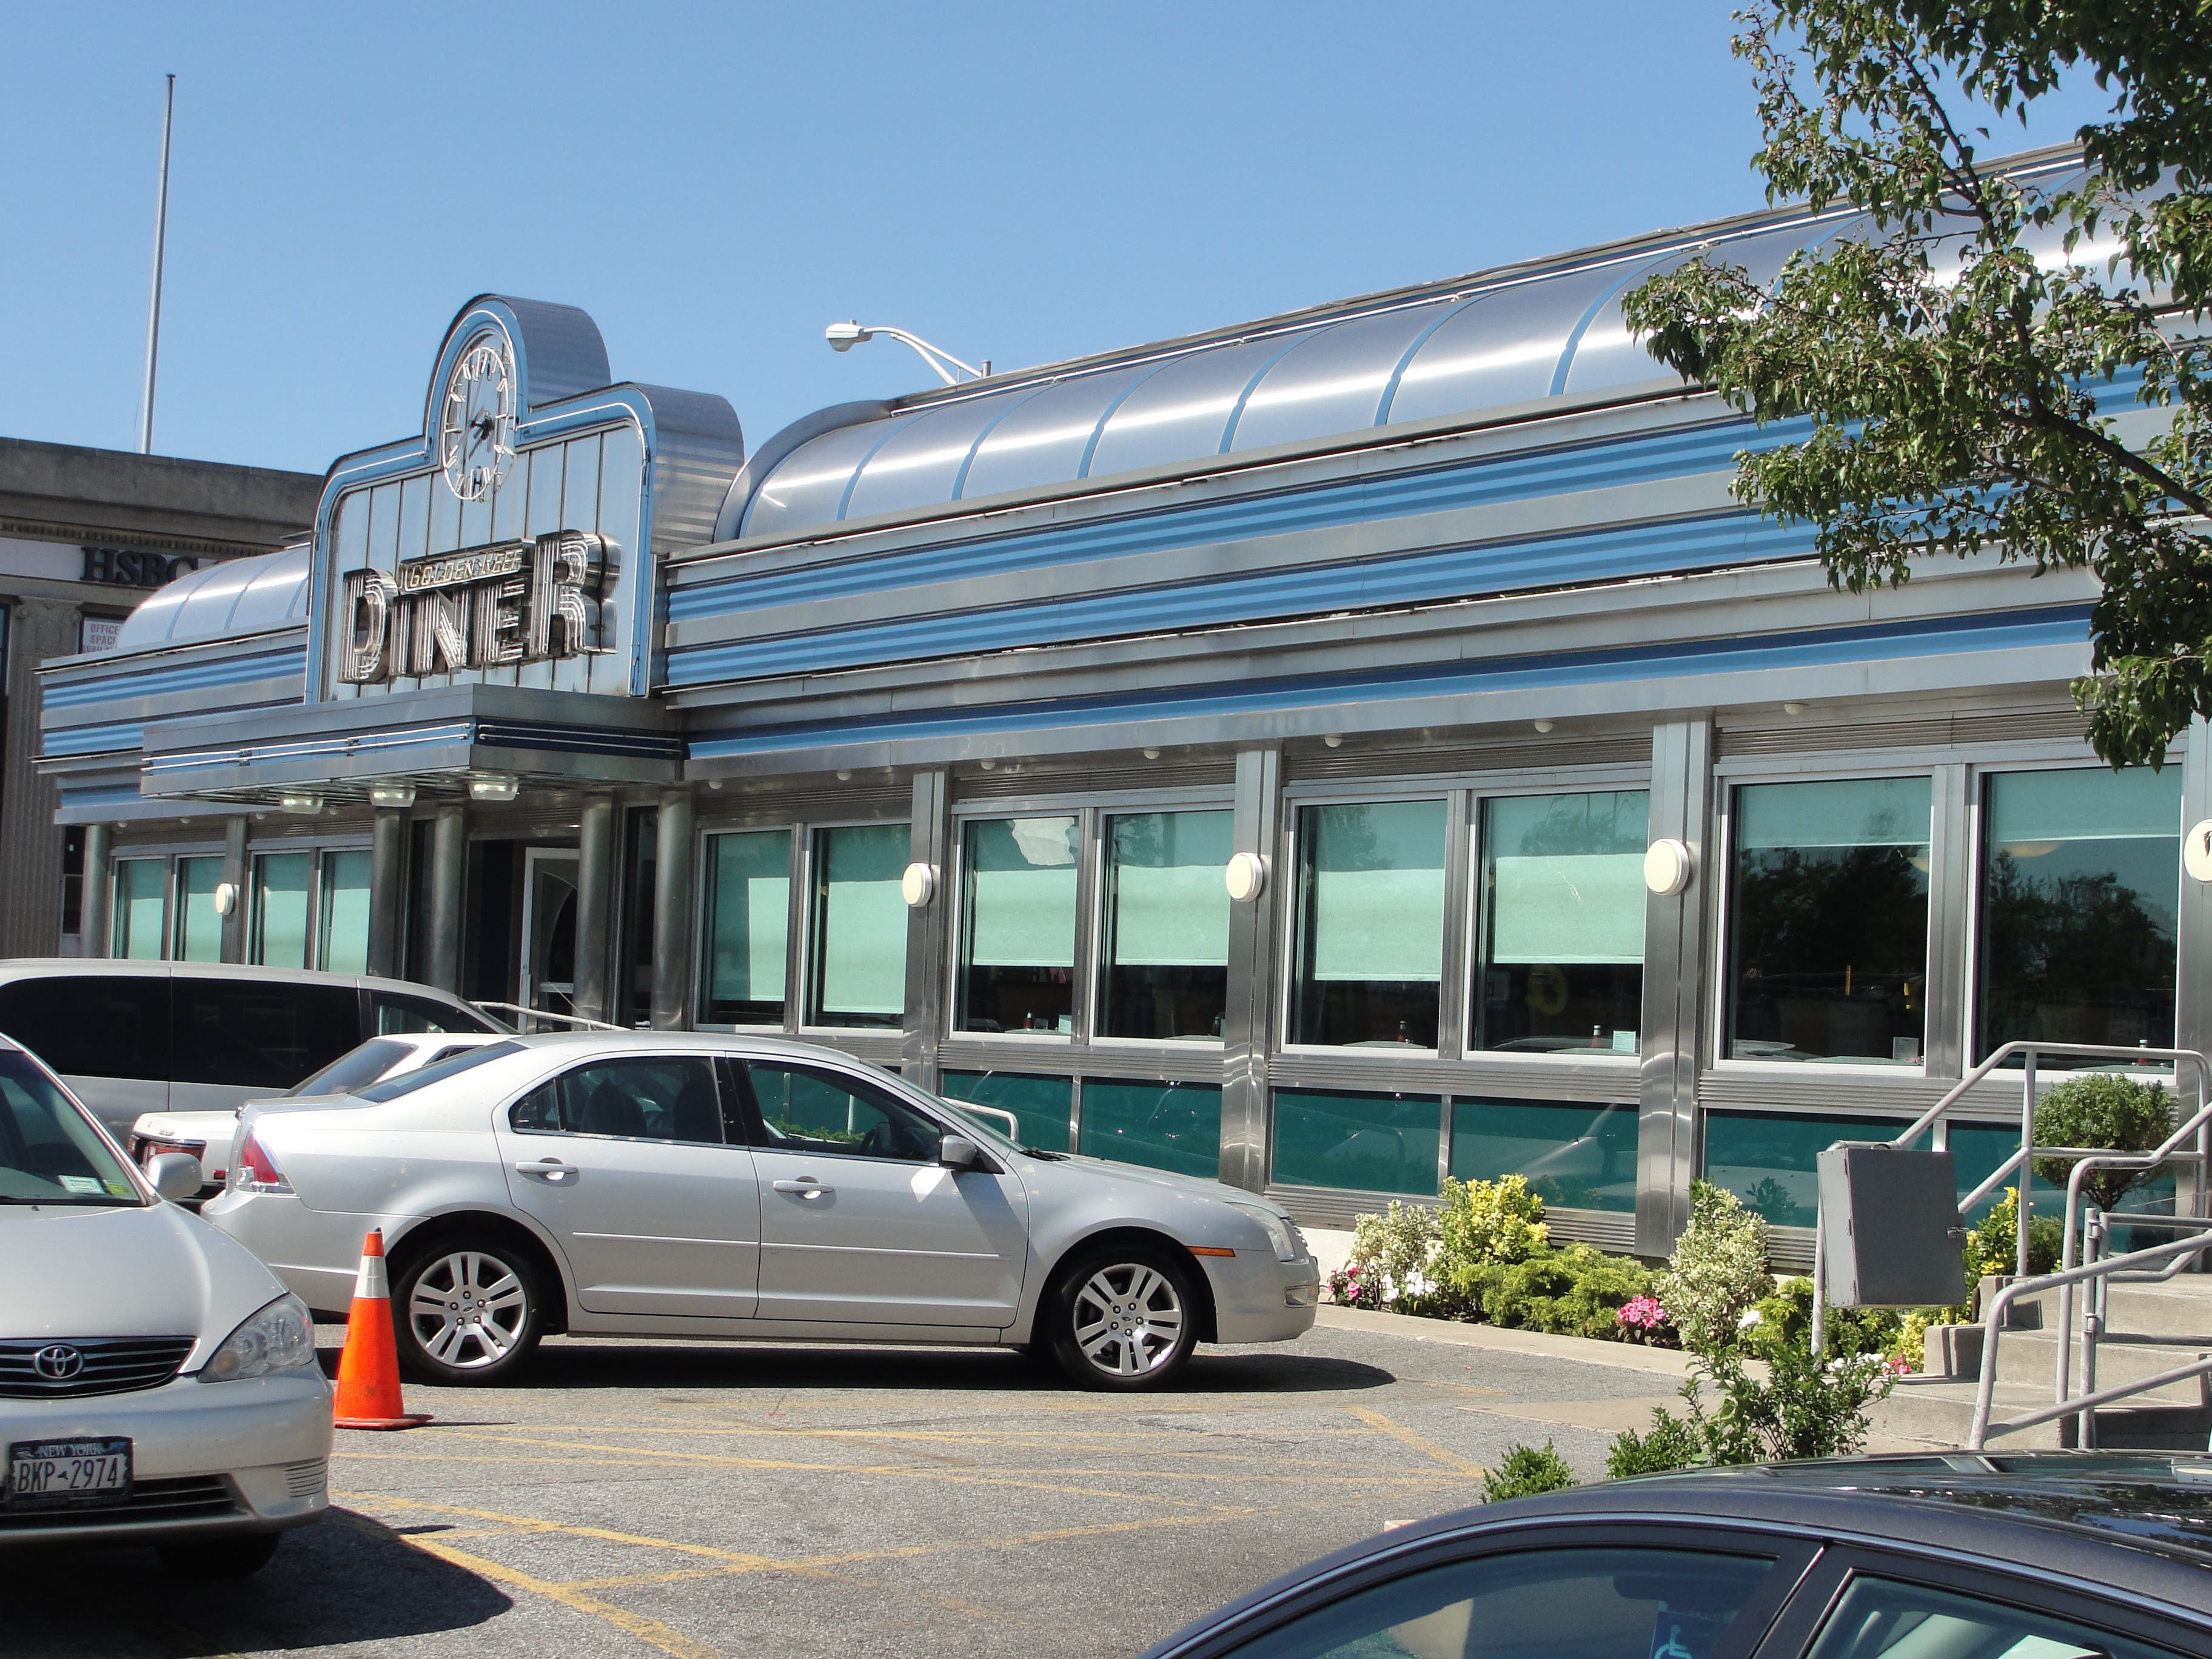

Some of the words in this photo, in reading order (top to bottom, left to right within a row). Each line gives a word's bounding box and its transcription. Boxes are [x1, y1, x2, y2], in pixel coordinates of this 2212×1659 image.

[80, 546, 199, 586] HSBC
[410, 560, 476, 588] GOLDEN
[481, 548, 523, 575] REEF
[338, 530, 623, 685] DINER
[90, 623, 119, 634] OFFICE
[38, 1445, 67, 1457] NEW
[71, 1444, 101, 1455] YORK
